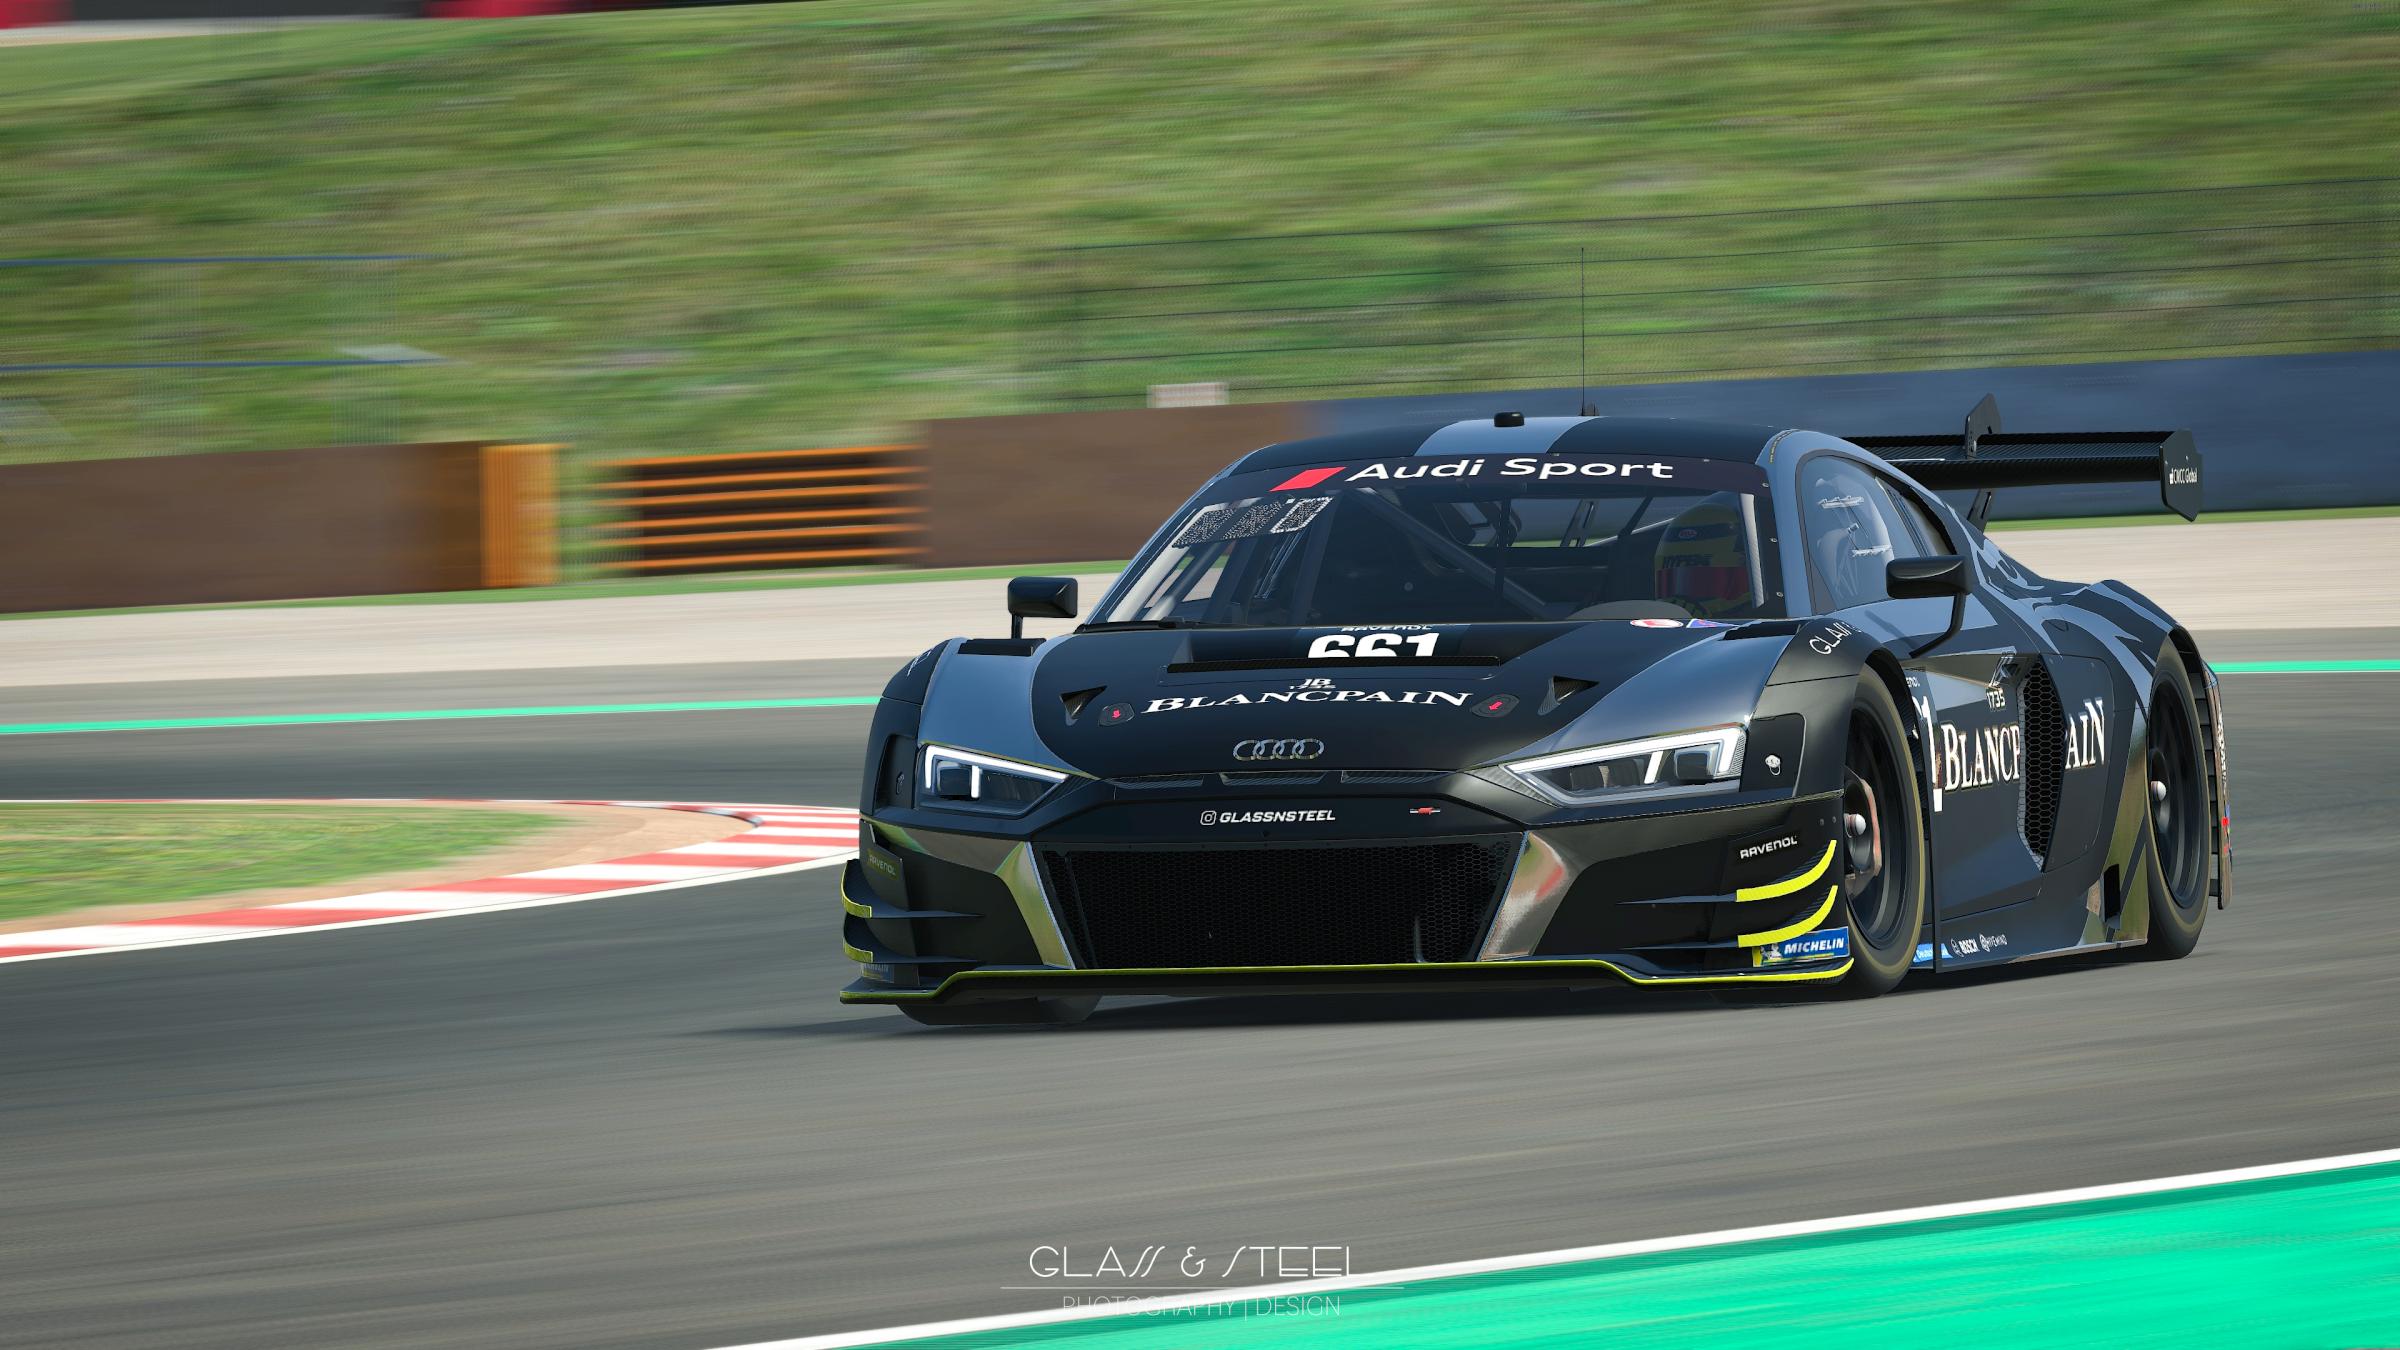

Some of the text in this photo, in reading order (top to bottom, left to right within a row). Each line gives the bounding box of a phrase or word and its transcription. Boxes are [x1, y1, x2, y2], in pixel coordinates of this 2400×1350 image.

[1345, 458, 1673, 481] Audi Sport
[1308, 633, 1440, 658] 661
[1141, 690, 1474, 714] BLANCPAIN
[1986, 688, 2006, 709] 1735
[1219, 809, 1336, 824] GLASSNSTEEL
[1740, 836, 1797, 859] RAVENOL
[868, 854, 896, 877] RAVENOL
[1784, 938, 1844, 955] MICHELIN
